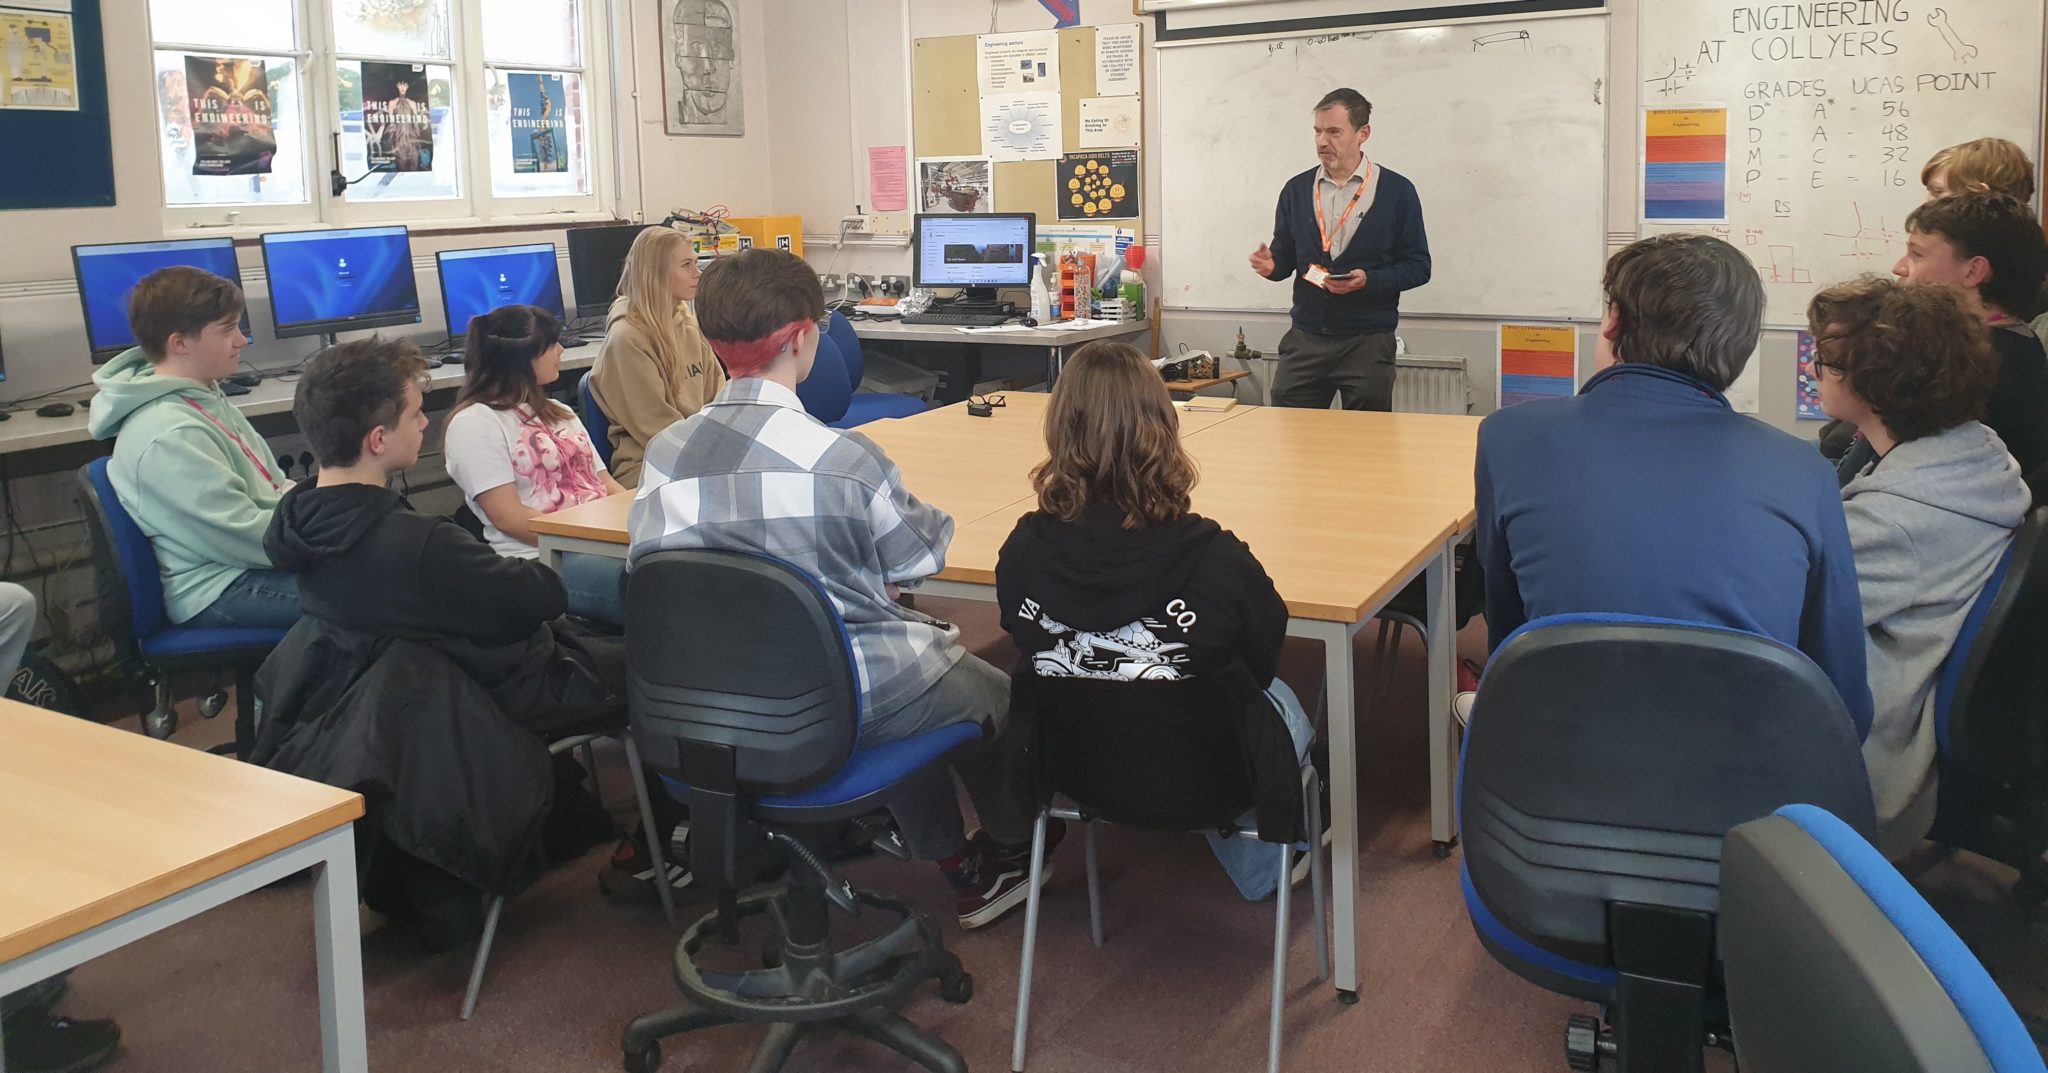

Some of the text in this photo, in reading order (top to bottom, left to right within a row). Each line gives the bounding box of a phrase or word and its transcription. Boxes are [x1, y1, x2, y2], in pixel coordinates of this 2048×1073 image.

[1732, 0, 1909, 33] ENGINEERING
[1697, 30, 1898, 65] AT COLLYERS
[1744, 71, 1997, 99] GRADES UCAS POINT
[193, 98, 266, 110] THIS IS
[367, 101, 426, 112] THIS IS
[513, 108, 563, 117] THIS IS
[1882, 101, 1910, 118] 56
[194, 112, 267, 124] ENGINEERING
[368, 114, 428, 124] ENGINEERING
[513, 120, 564, 128] ENGINEERING
[1748, 128, 1762, 143] D
[1812, 126, 1828, 142] A
[1882, 124, 1908, 142] 48
[1747, 148, 1762, 165] M
[1812, 148, 1826, 164] C
[1881, 146, 1909, 164] 32
[1746, 169, 1760, 186] P
[1811, 171, 1824, 189] E
[1884, 169, 1906, 186] 16
[1018, 597, 1196, 633] VA CO.
